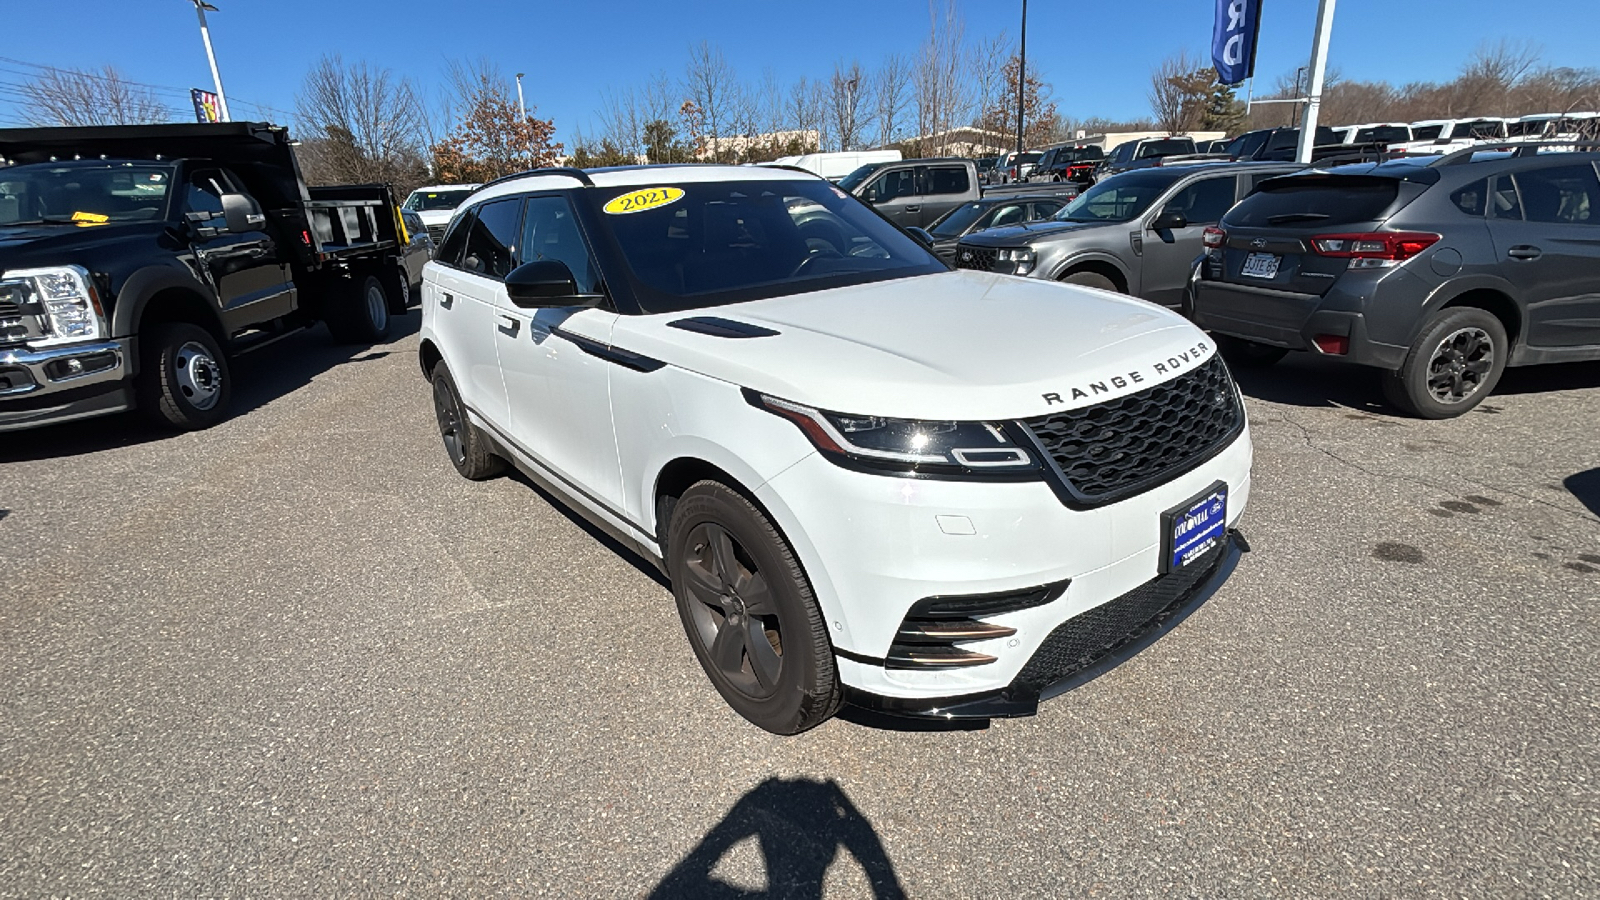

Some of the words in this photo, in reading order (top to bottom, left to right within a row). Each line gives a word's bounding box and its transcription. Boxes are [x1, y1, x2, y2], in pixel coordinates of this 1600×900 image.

[620, 189, 672, 211] 2021
[1042, 371, 1144, 406] RANGE
[1153, 342, 1209, 375] ROVER
[1174, 508, 1209, 539] COLONIAL
